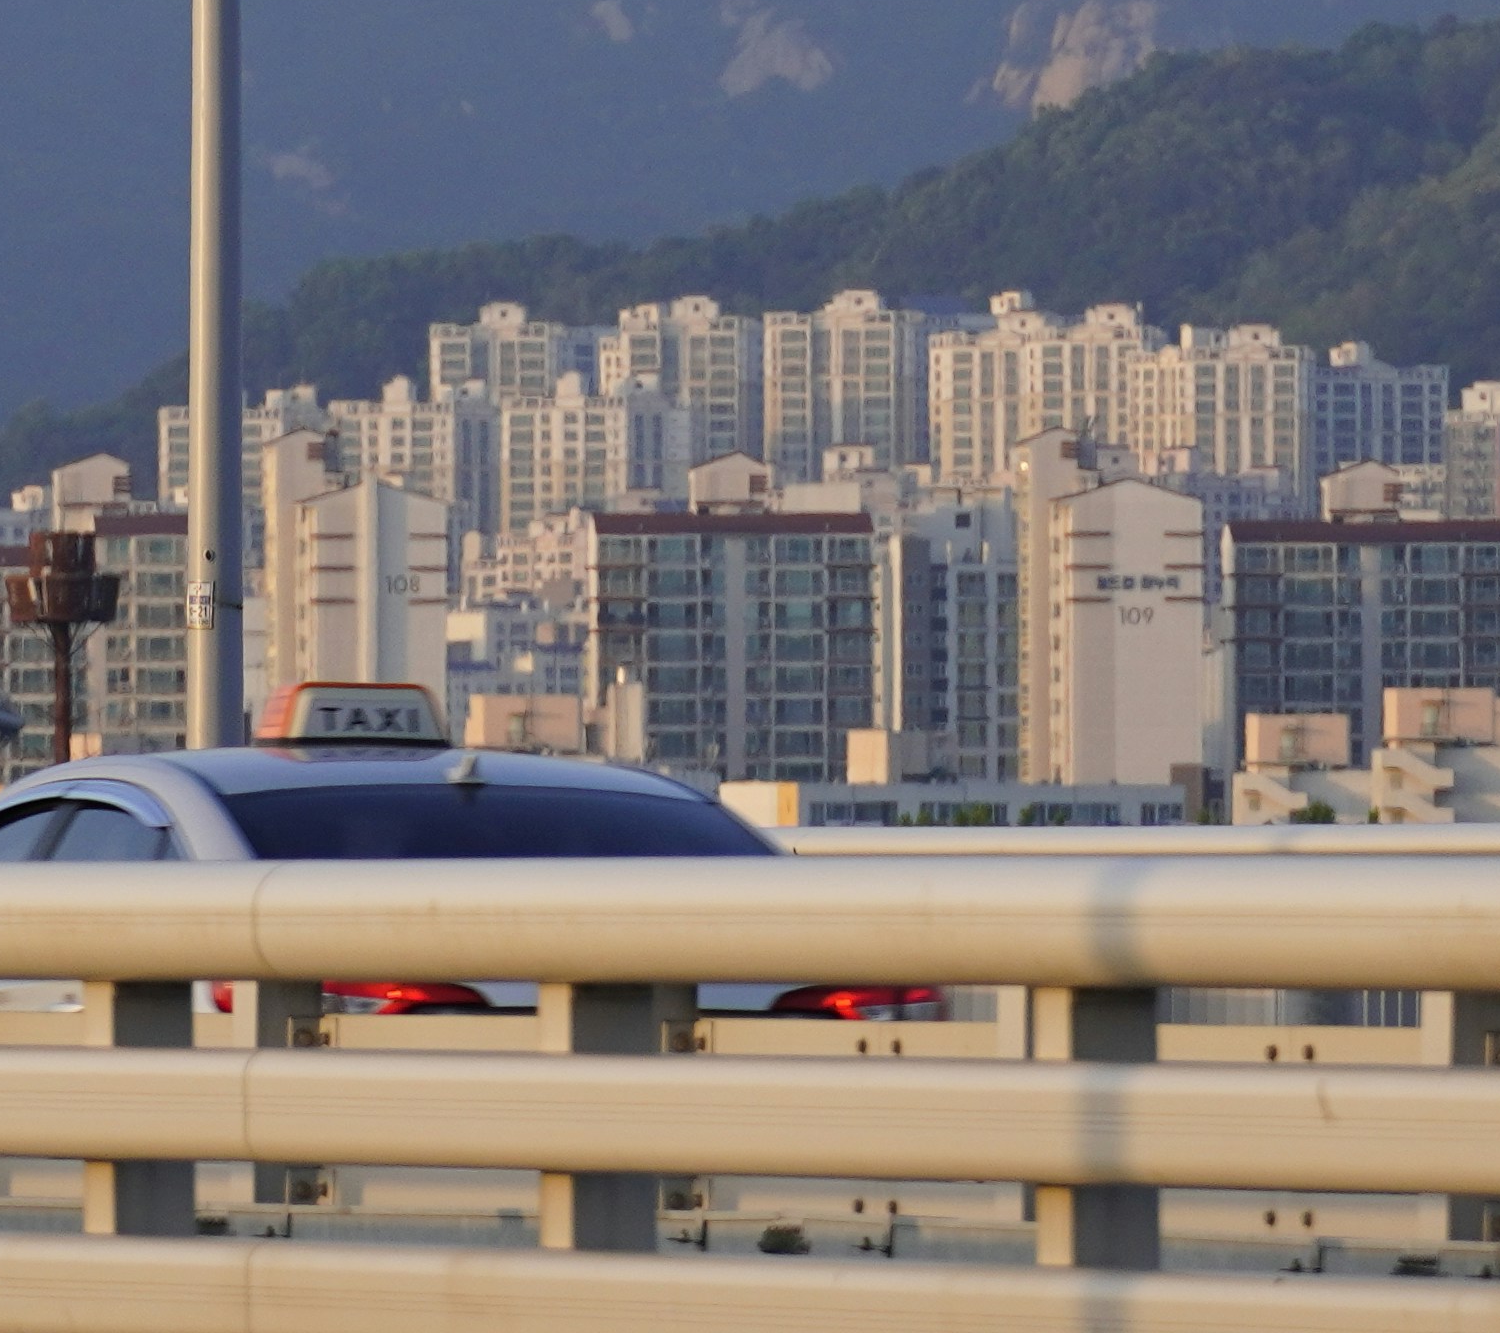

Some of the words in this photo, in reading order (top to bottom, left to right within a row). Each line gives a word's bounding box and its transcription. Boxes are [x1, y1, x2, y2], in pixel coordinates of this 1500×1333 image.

[385, 574, 419, 594] 108
[1119, 606, 1154, 625] 109
[316, 706, 421, 733] TAXI
